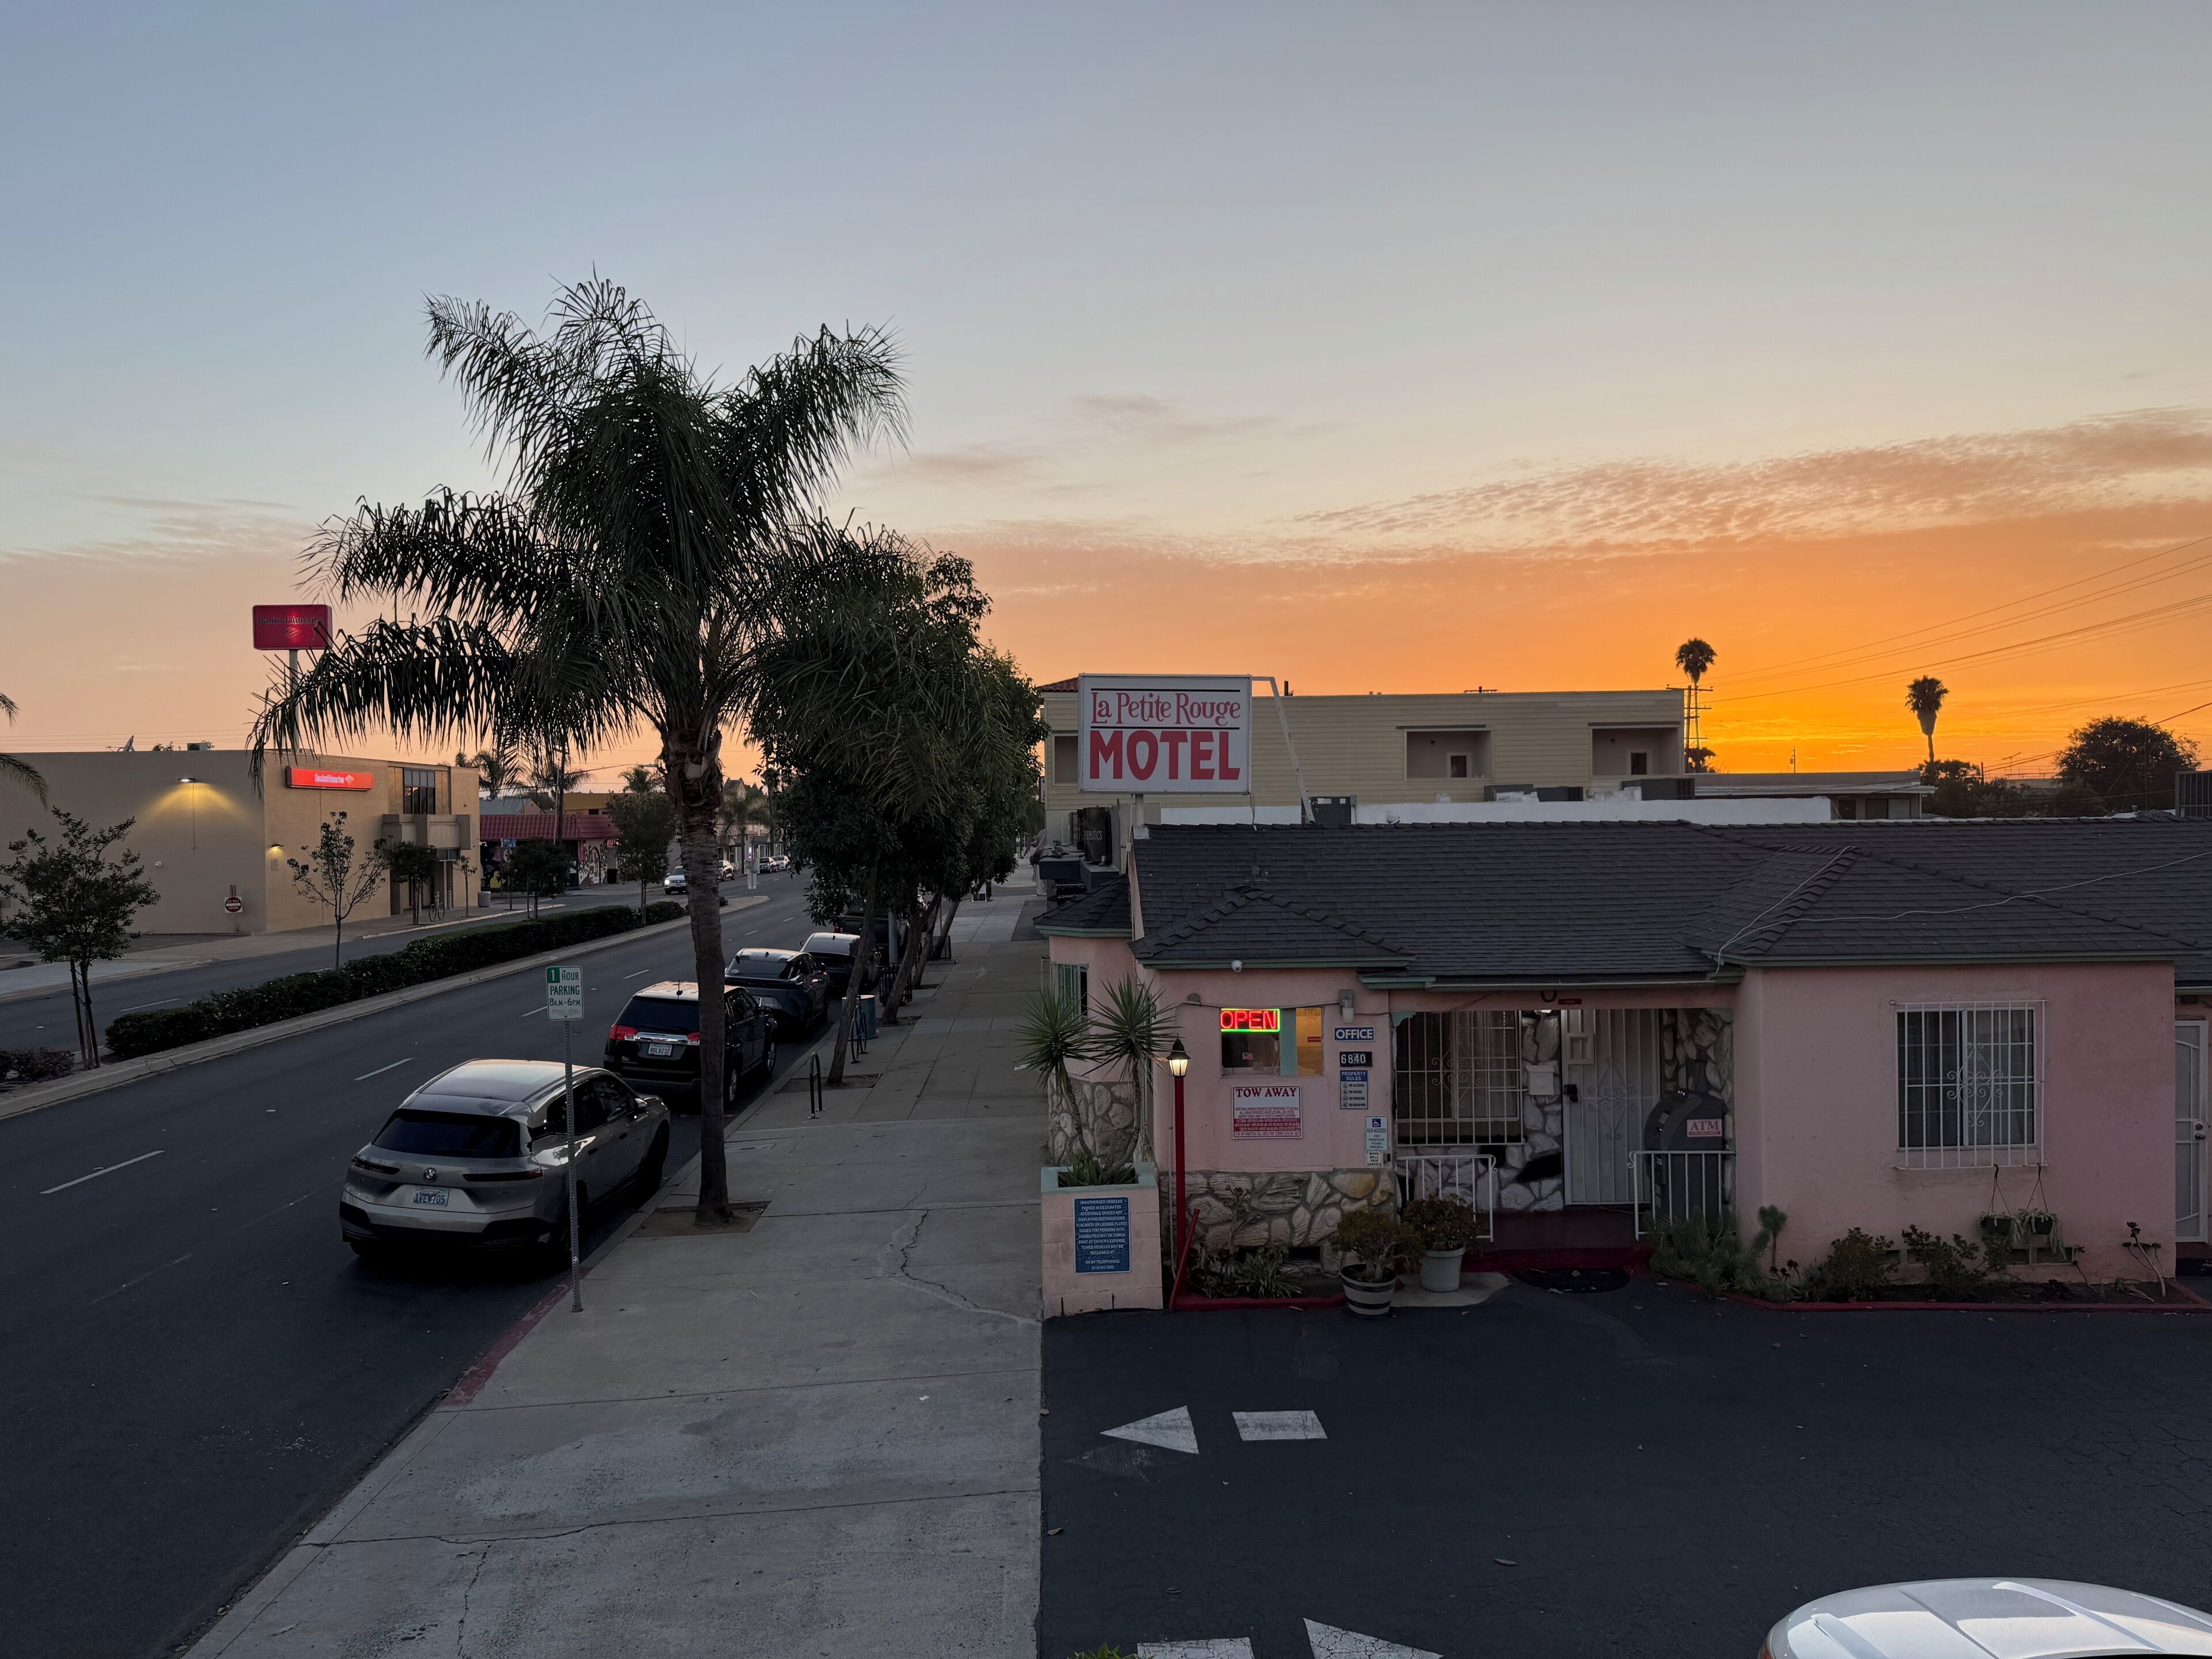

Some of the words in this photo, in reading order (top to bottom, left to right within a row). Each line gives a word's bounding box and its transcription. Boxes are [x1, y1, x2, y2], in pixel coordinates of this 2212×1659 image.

[1091, 692, 1112, 724] La
[1116, 692, 1171, 724] Petite
[1175, 693, 1241, 726] Rouge
[1089, 730, 1240, 781] MOTEL
[551, 969, 555, 982] 1
[562, 972, 579, 980] HOUR
[550, 985, 580, 995] PARKING
[1220, 1010, 1277, 1029] OPEN
[1336, 1029, 1373, 1039] OFFICE
[1341, 1054, 1366, 1064] 6840
[1236, 1088, 1262, 1097] TOW
[1265, 1088, 1297, 1097] AWAY
[1690, 1120, 1719, 1131] ATM
